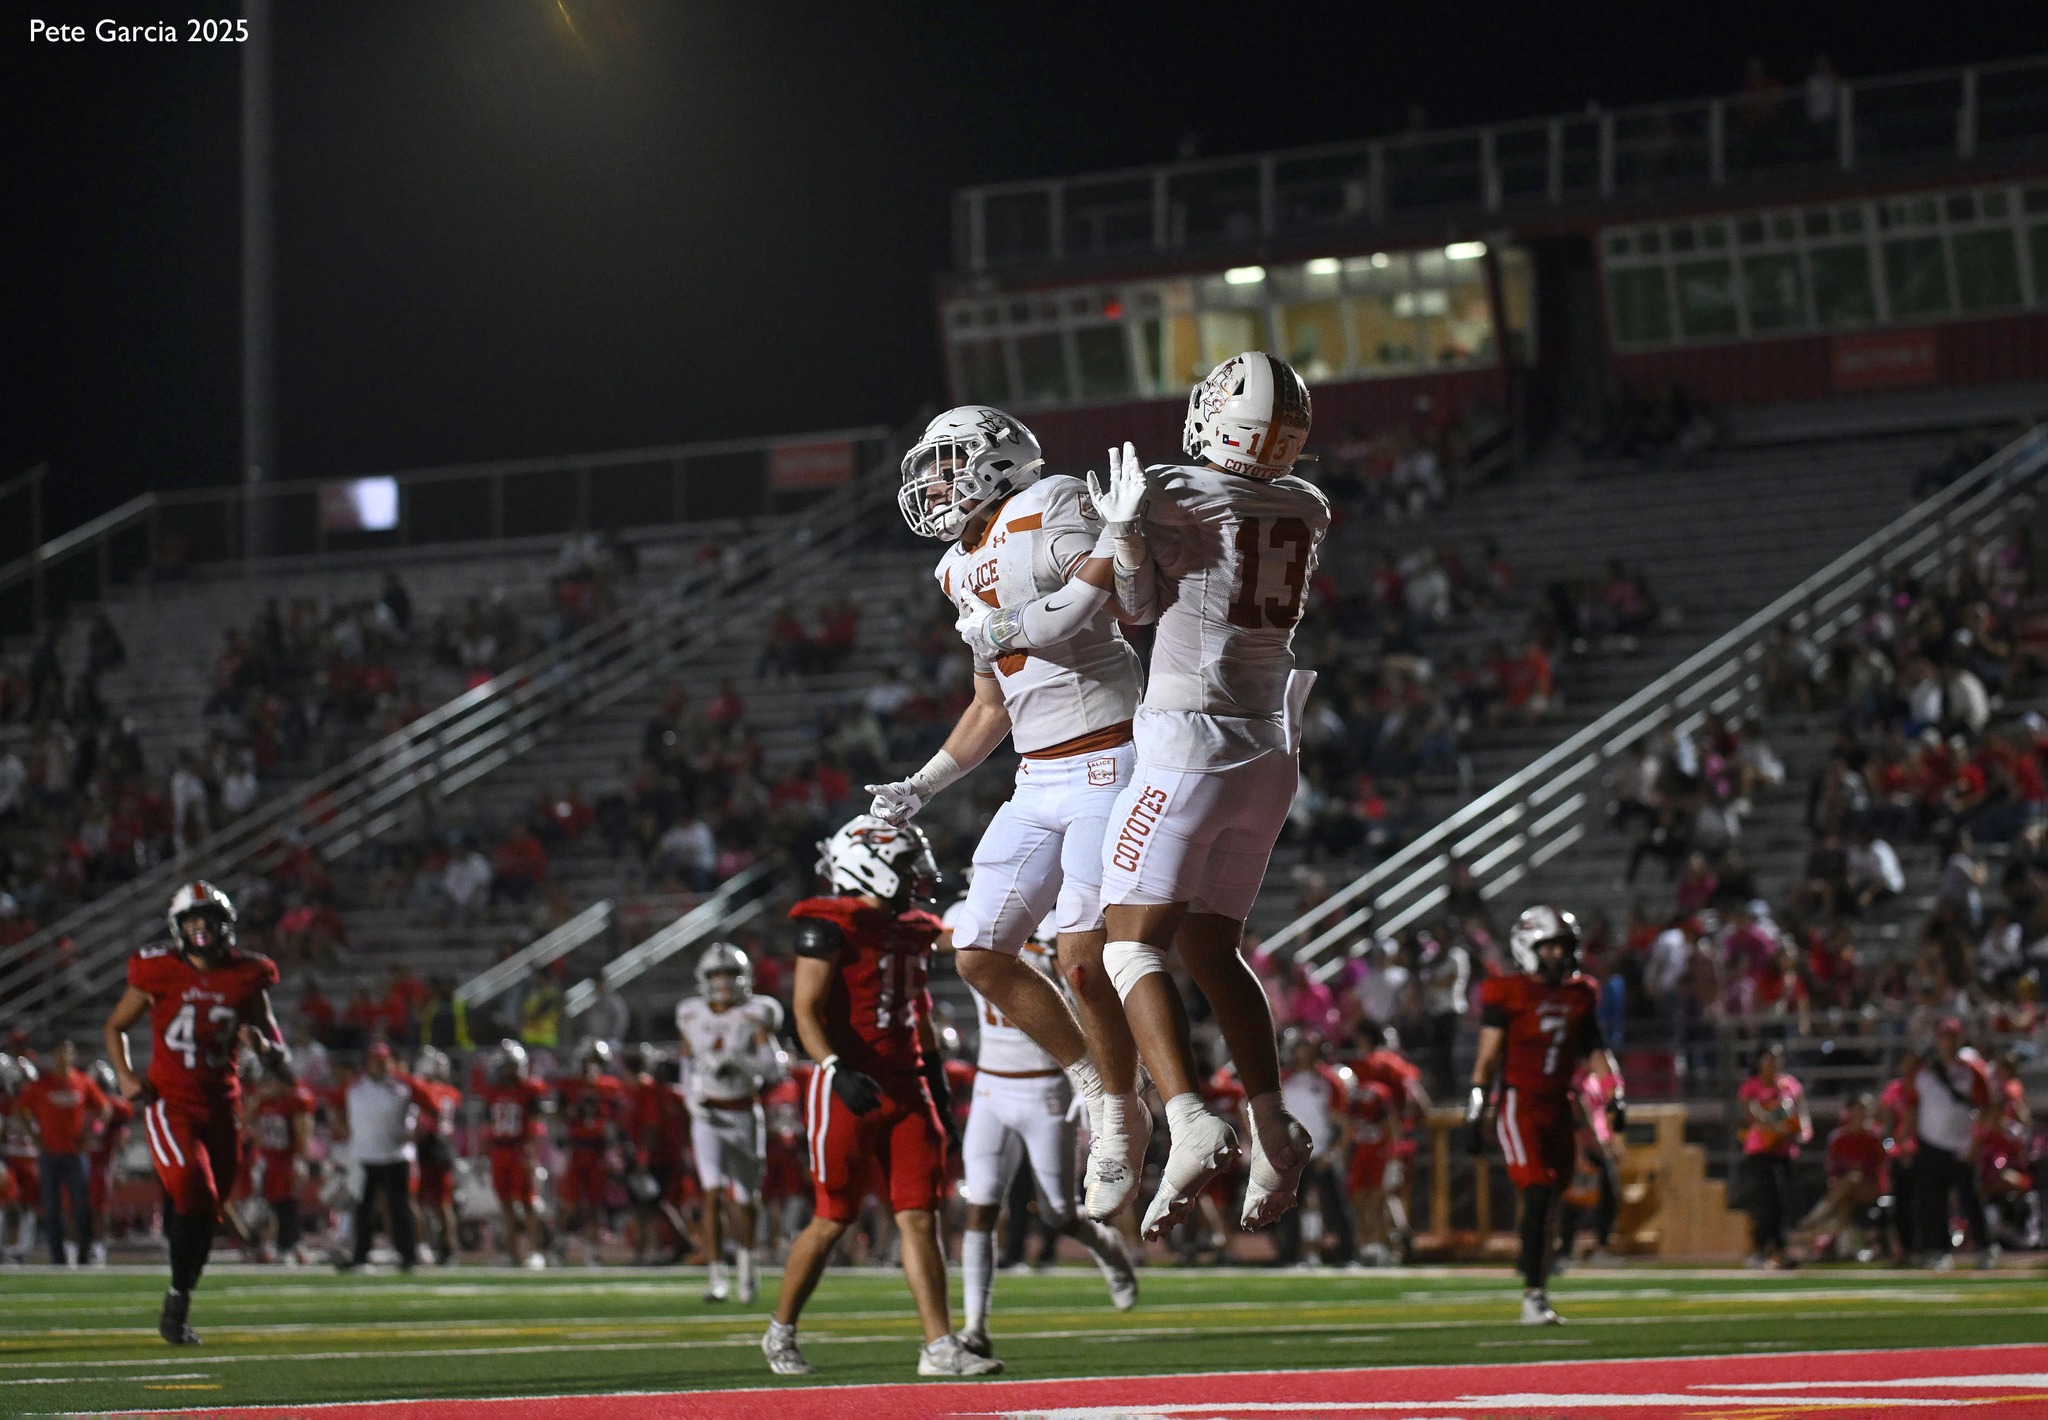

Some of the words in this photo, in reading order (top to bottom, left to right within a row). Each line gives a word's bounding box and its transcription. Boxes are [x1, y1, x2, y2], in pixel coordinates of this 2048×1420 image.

[1227, 517, 1311, 629] 13
[1091, 760, 1111, 768] ALICE
[1113, 785, 1168, 873] COYOTES
[164, 1003, 238, 1069] 43
[1539, 1016, 1568, 1076] 7
